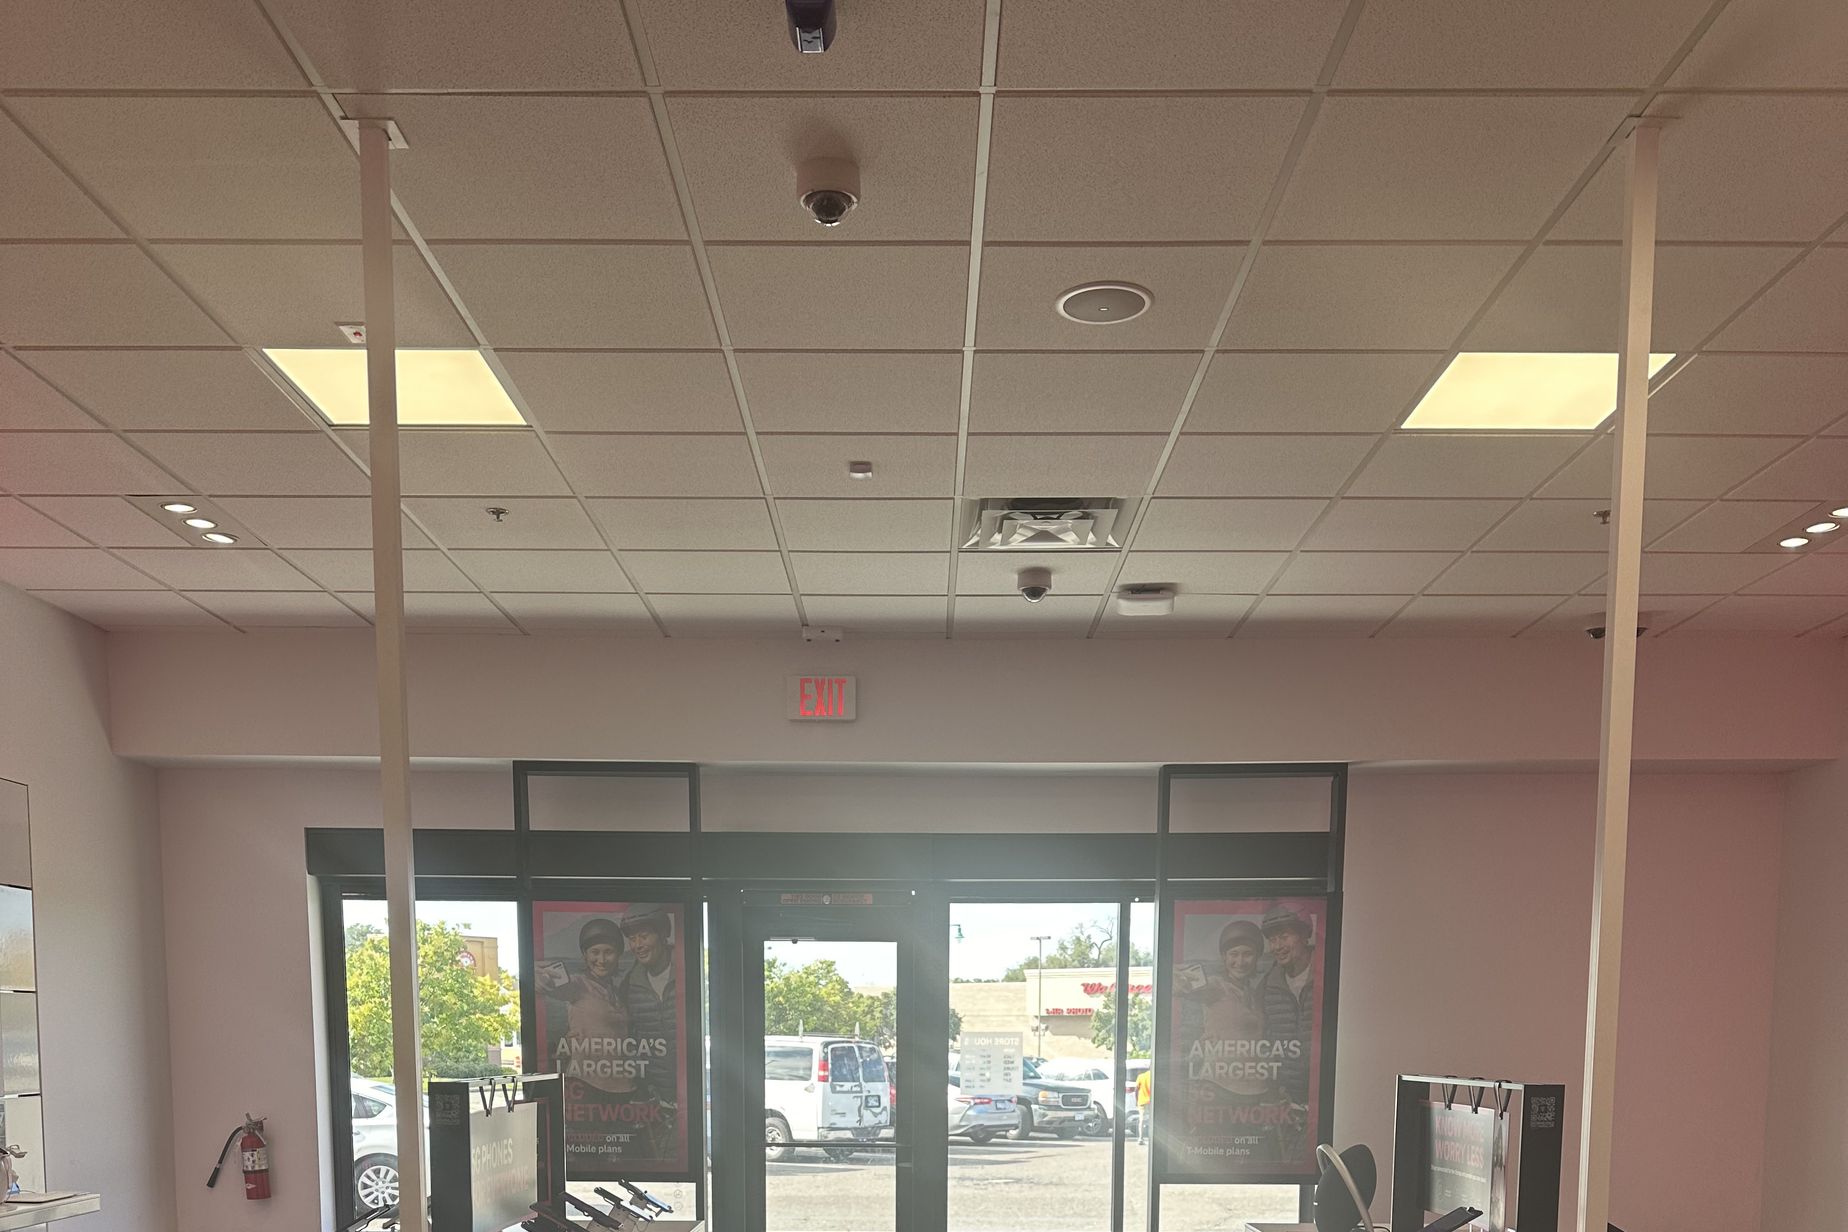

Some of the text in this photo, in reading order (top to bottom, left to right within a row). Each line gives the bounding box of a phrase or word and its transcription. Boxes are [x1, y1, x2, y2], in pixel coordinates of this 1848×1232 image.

[800, 678, 847, 717] EXIT
[556, 1037, 668, 1057] AMERICA'S
[1188, 1039, 1301, 1058] AMERICA'S
[556, 1060, 650, 1079] LARGEST
[1188, 1062, 1282, 1080] LARGEST
[1188, 1105, 1293, 1124] NETWORK
[1435, 1114, 1462, 1137] KNOW
[619, 1134, 630, 1142] all
[481, 1137, 513, 1169] PHONES
[567, 1144, 623, 1154] Mobile plans
[1225, 1146, 1251, 1156] plans
[1434, 1138, 1485, 1169] WORRY LESS
